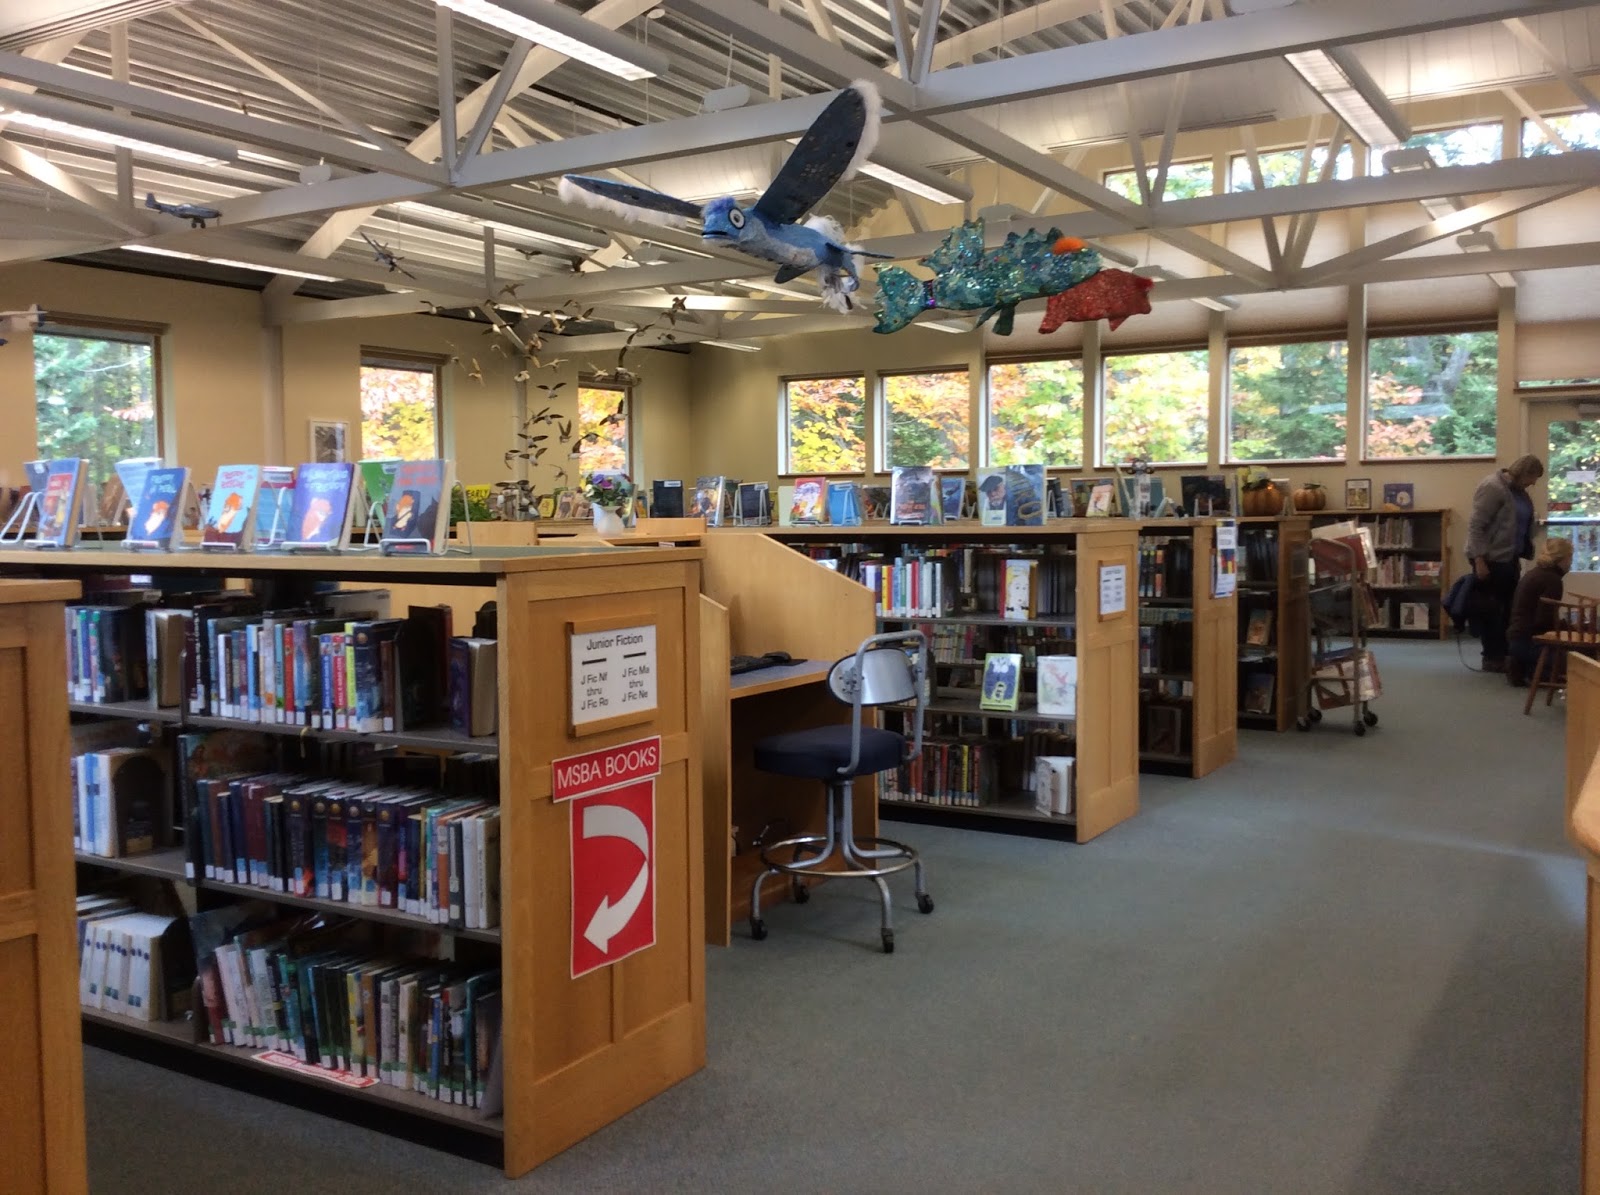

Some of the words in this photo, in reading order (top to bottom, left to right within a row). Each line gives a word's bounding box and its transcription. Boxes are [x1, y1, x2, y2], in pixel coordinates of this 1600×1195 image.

[586, 637, 614, 651] Junior
[616, 633, 643, 647] Fiction
[622, 668, 627, 678] J
[628, 667, 638, 676] Fic
[639, 665, 650, 675] Ma
[580, 675, 586, 686] J
[587, 674, 598, 683] Fic
[629, 679, 644, 689] thru
[586, 686, 602, 697] thru
[622, 693, 627, 703] J
[628, 692, 638, 700] Fic
[581, 700, 586, 711] J
[587, 699, 598, 708] Fic
[557, 760, 602, 789] MSBA
[605, 746, 656, 777] BOOKS
